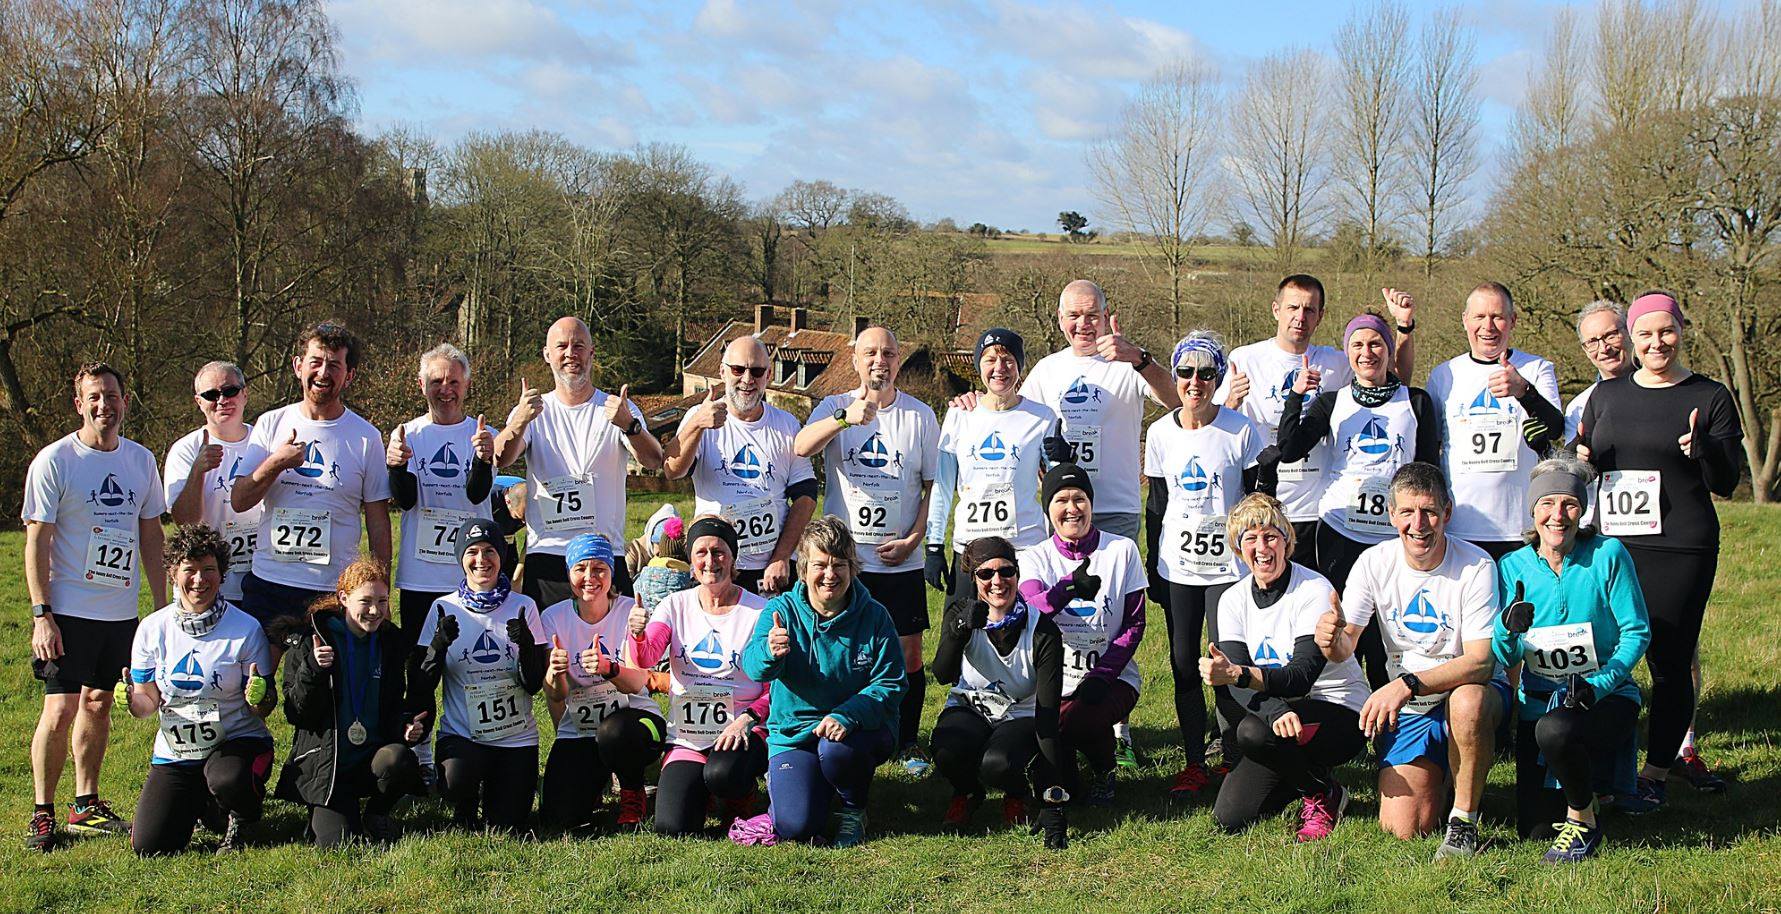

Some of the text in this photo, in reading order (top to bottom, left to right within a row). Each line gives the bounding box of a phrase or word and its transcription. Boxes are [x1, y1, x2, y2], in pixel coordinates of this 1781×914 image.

[1472, 432, 1502, 455] 97
[552, 491, 582, 514] 75
[967, 500, 1009, 523] 276
[1356, 492, 1388, 516] 18
[1606, 490, 1651, 515] 102
[736, 512, 775, 540] 262
[858, 506, 887, 528] 92
[277, 524, 322, 548] 272
[433, 525, 461, 547] 74
[1180, 530, 1225, 557] 255
[95, 544, 133, 572] 121
[1063, 649, 1101, 672] 10
[1533, 644, 1589, 670] 103
[477, 694, 520, 725] 151
[682, 701, 728, 725] 176
[169, 721, 217, 745] 175
